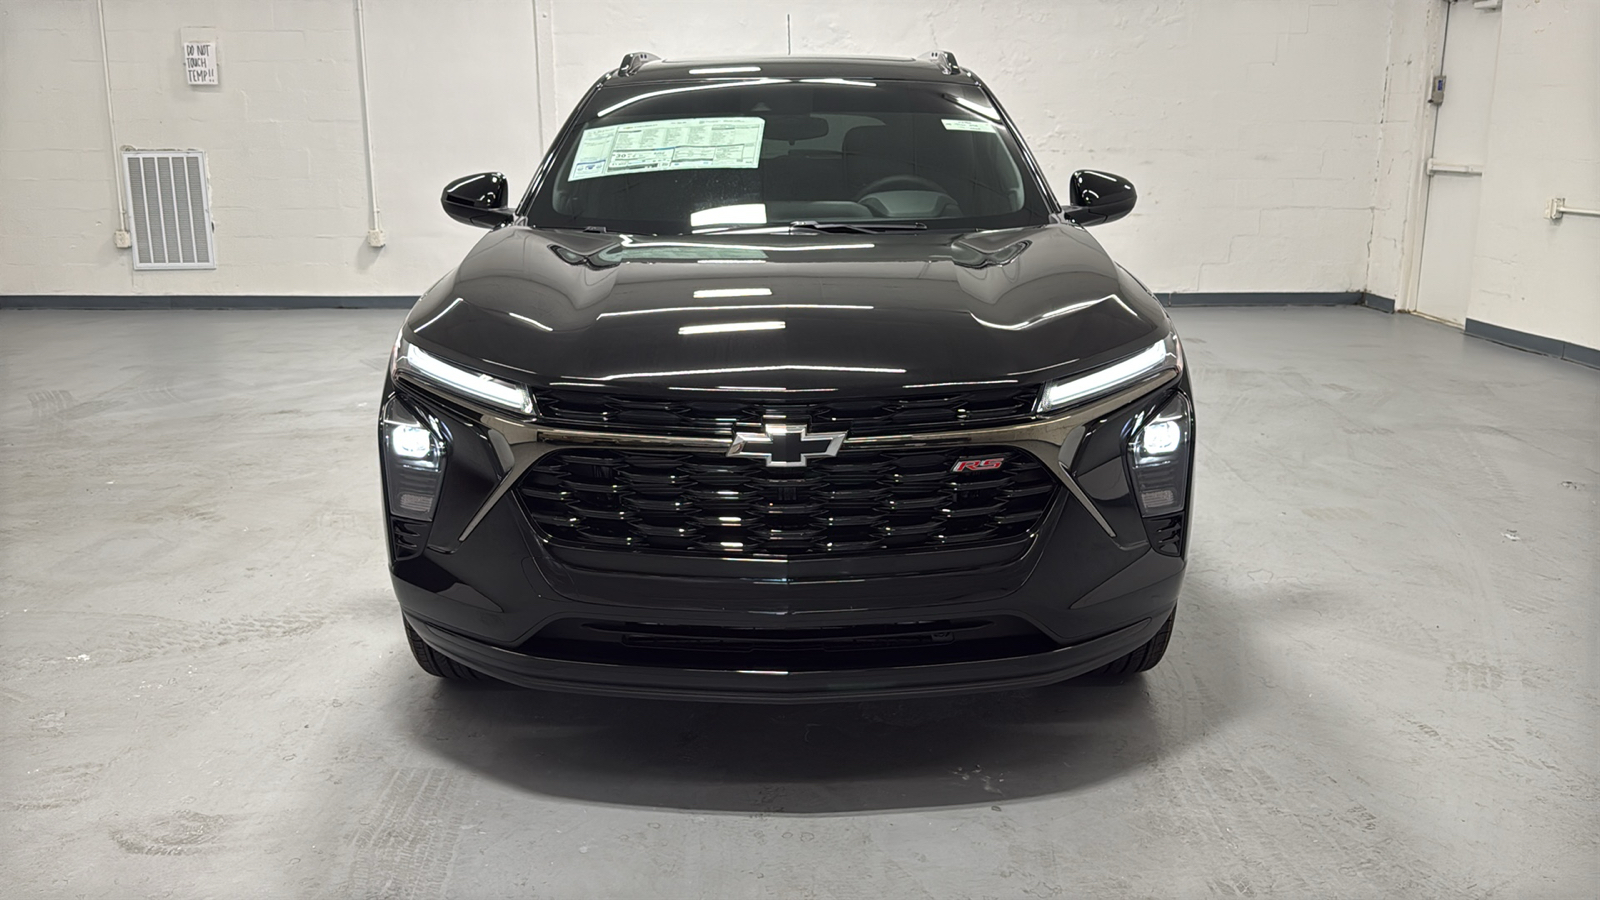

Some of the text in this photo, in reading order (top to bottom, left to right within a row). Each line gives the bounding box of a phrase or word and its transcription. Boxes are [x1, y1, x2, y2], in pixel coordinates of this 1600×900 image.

[186, 44, 210, 57] DO NOT
[186, 57, 207, 69] TOUCH
[188, 68, 215, 82] TEMP!!
[952, 457, 1005, 472] RS
